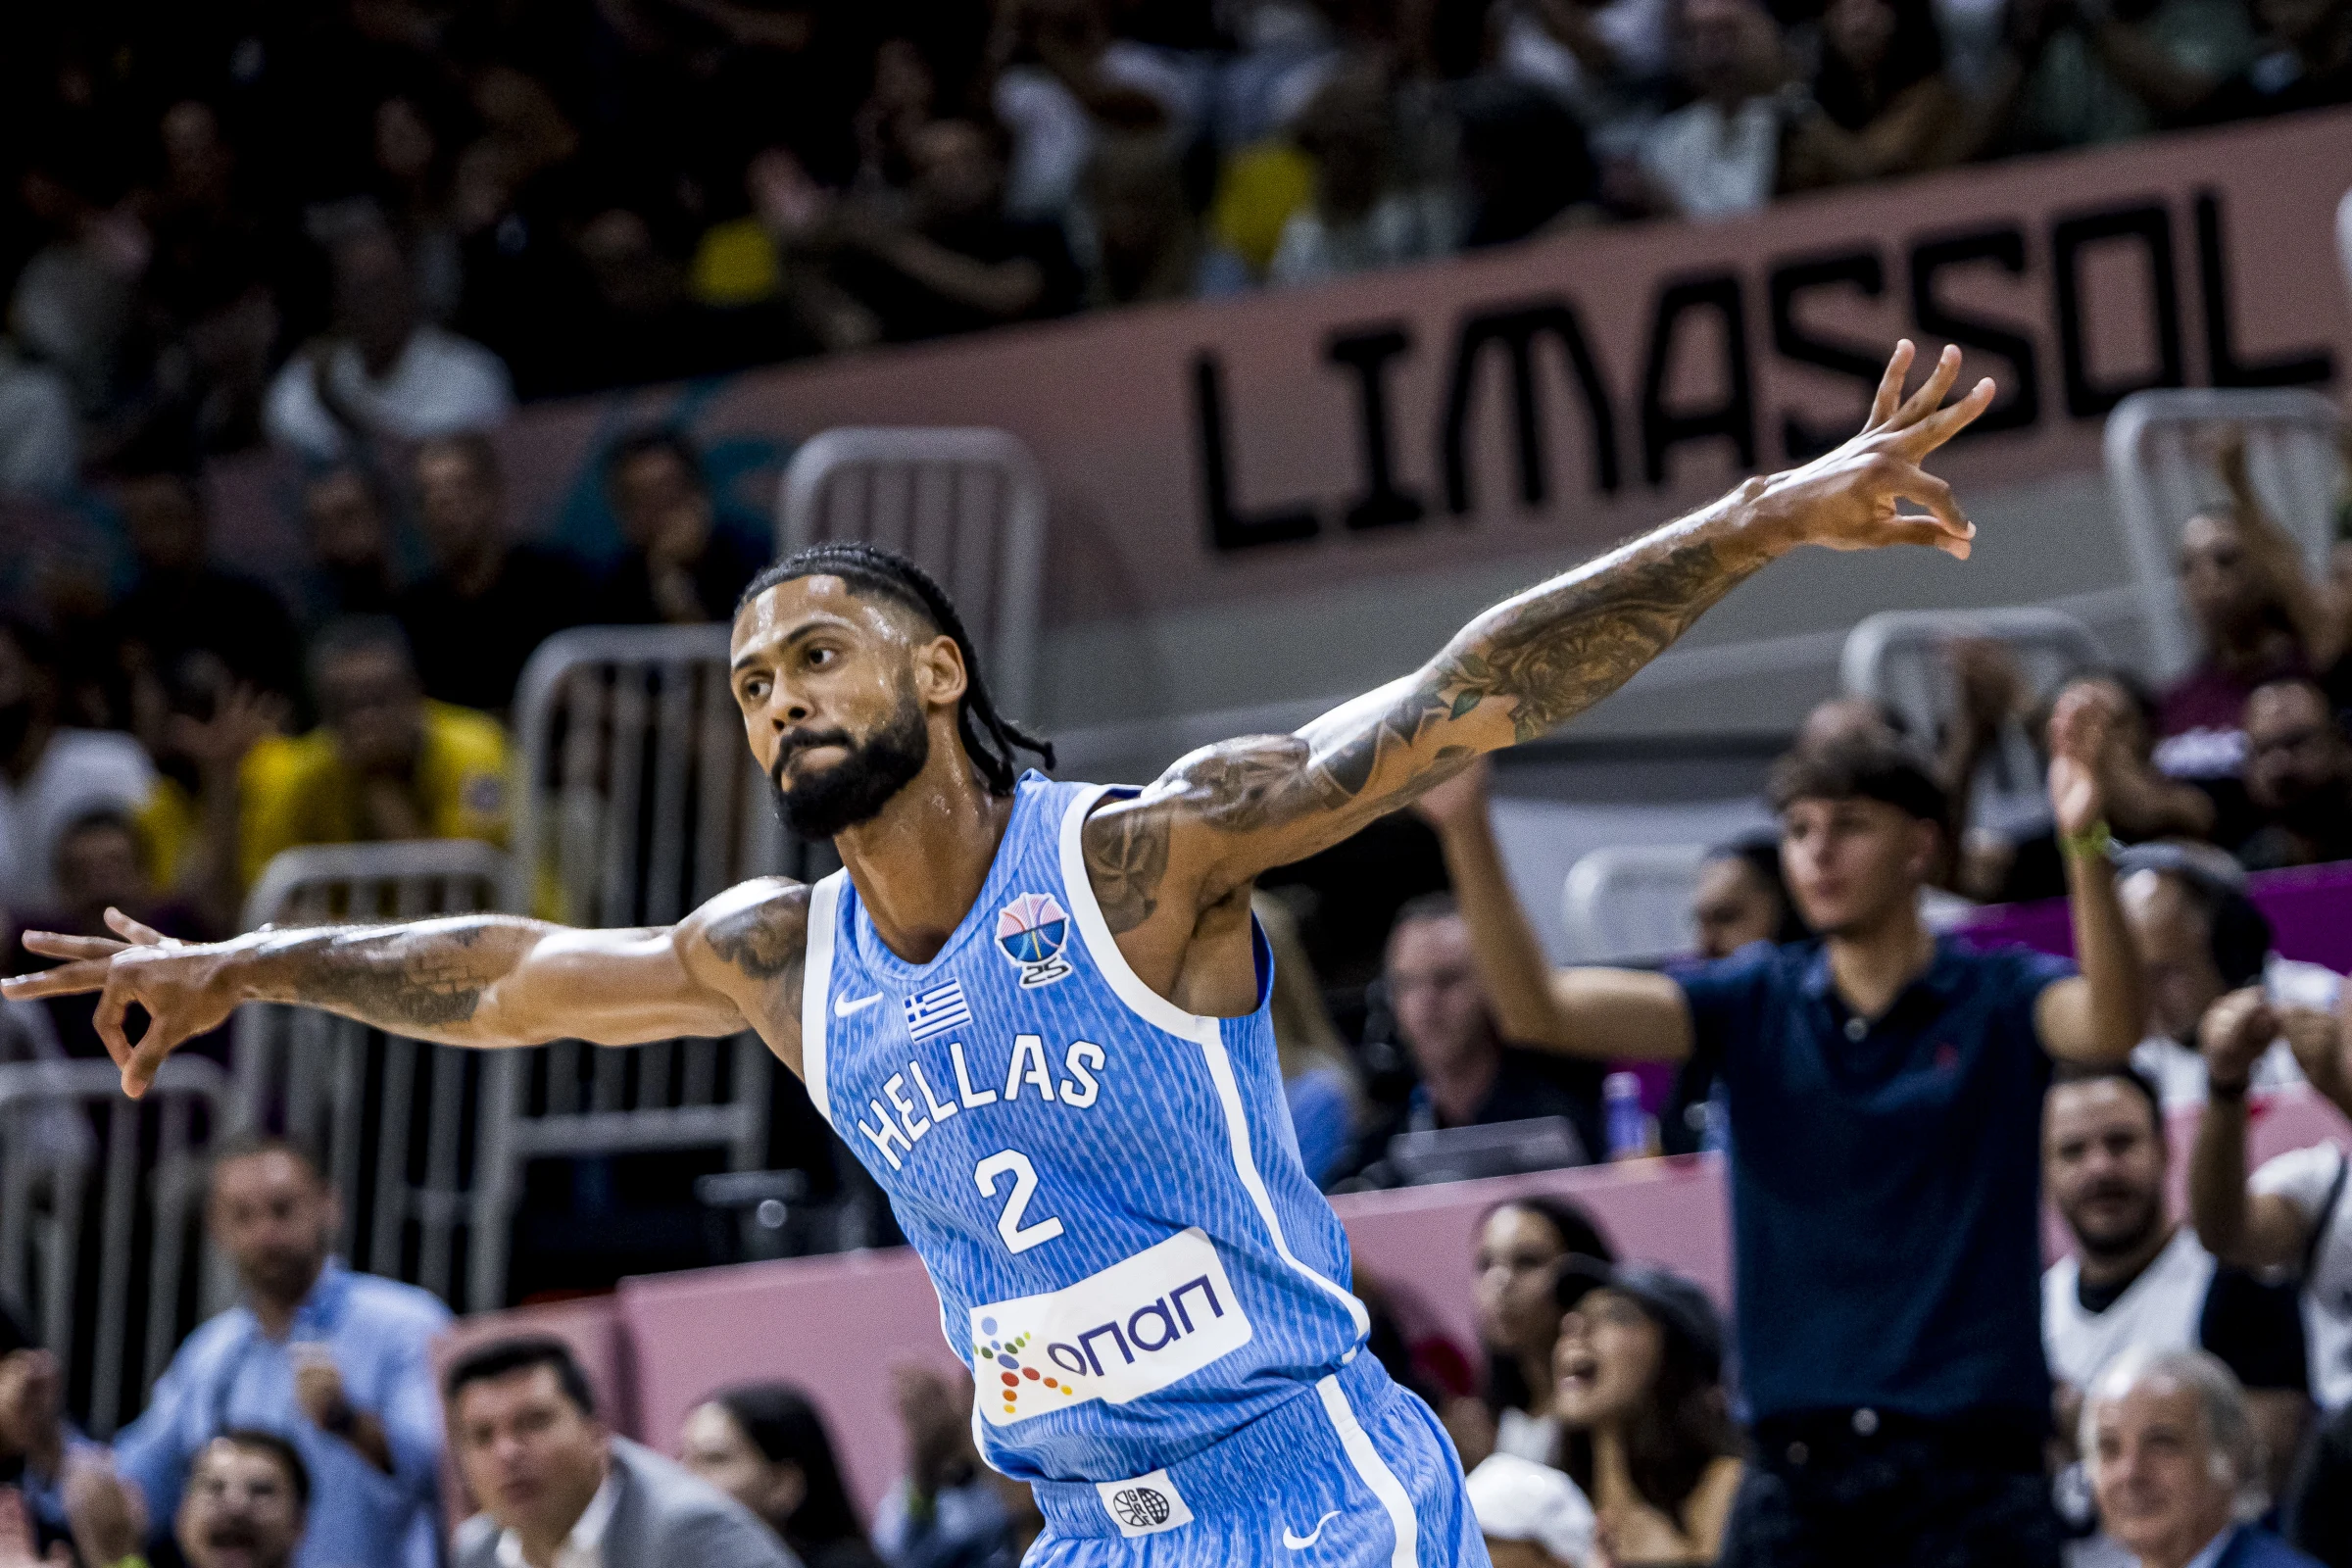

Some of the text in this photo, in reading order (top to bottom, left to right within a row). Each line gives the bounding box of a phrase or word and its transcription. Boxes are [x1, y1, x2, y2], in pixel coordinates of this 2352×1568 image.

[1188, 186, 2334, 552] LIMASSOL
[1022, 956, 1069, 985] 25
[857, 1033, 1107, 1172] HELLAS
[973, 1148, 1065, 1255] 2
